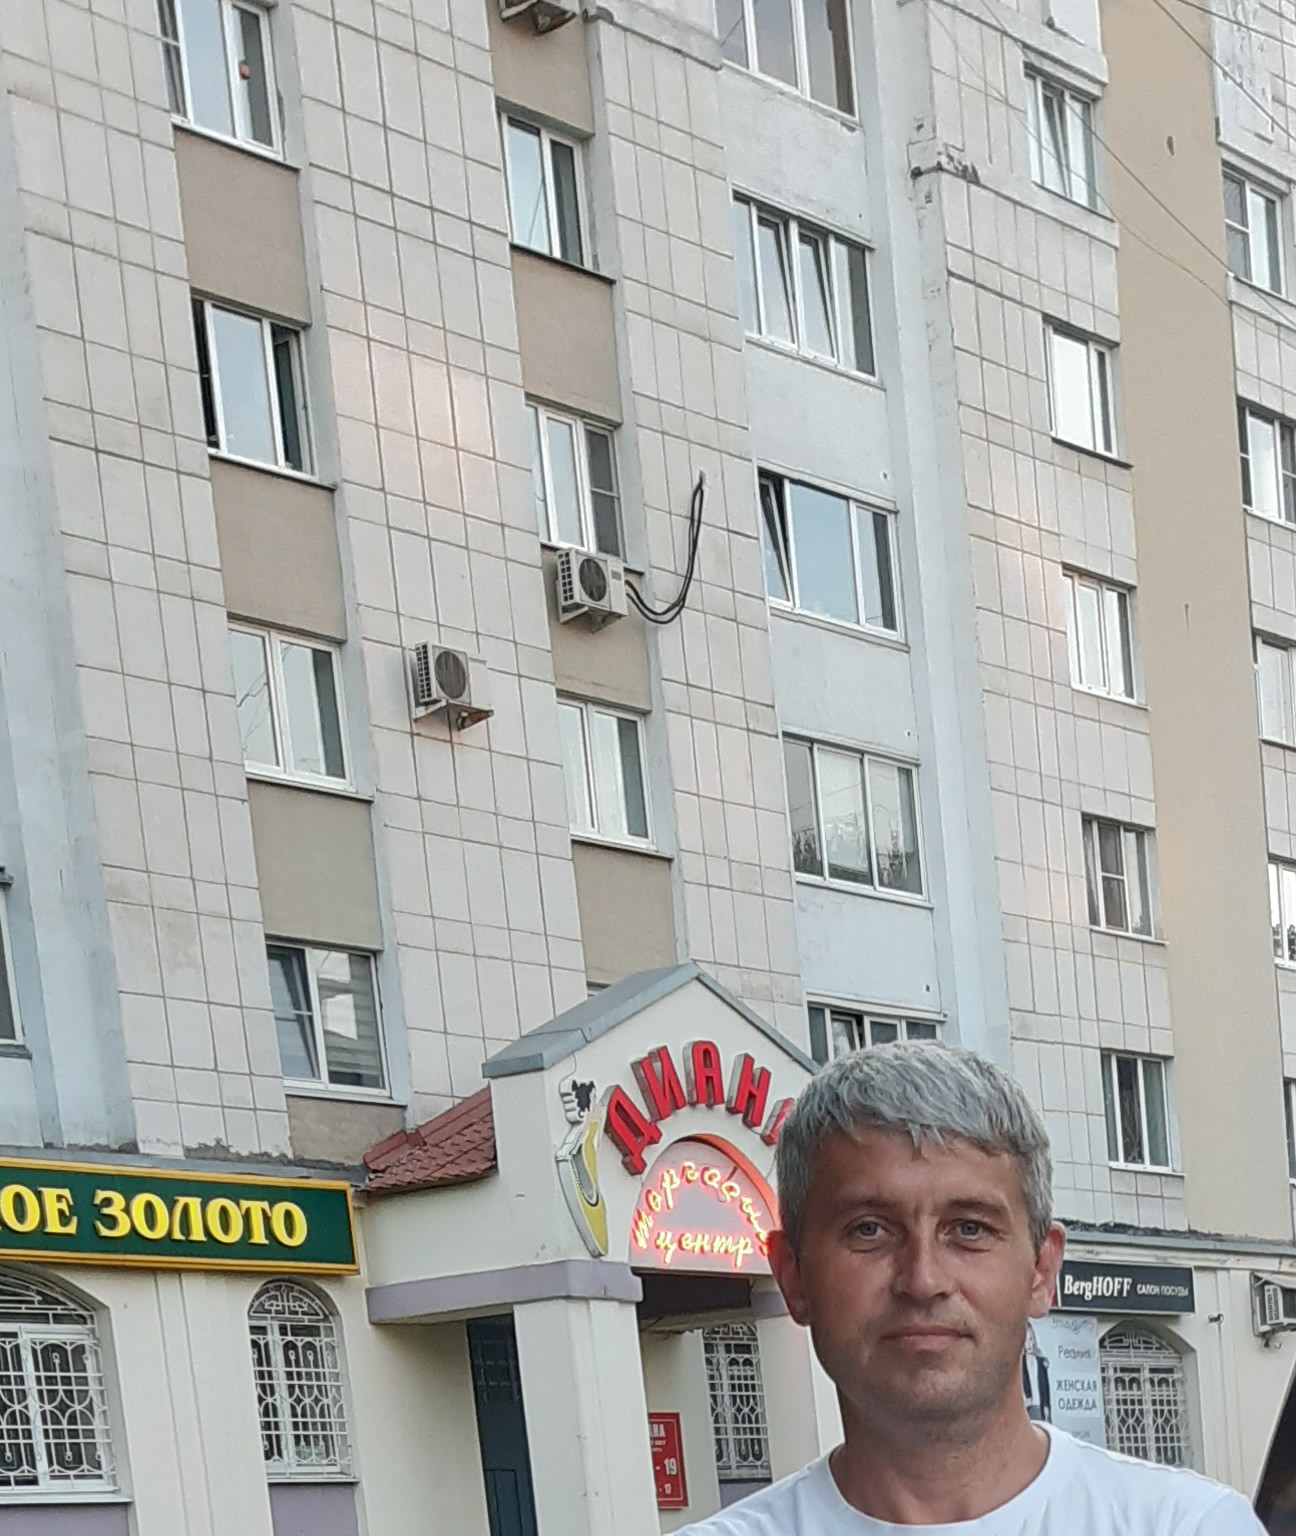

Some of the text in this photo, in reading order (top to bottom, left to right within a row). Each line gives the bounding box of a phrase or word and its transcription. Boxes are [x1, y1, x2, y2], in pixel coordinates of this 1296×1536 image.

[0, 1184, 308, 1248] ОЕ ЗОЛОТО
[656, 1229, 754, 1269] центр
[1064, 1274, 1133, 1301] BergHOFF
[1136, 1284, 1160, 1296] САЛОН
[1056, 1379, 1098, 1392] ЖЕНСКАЯ
[1058, 1397, 1098, 1411] ОДЕЖДА
